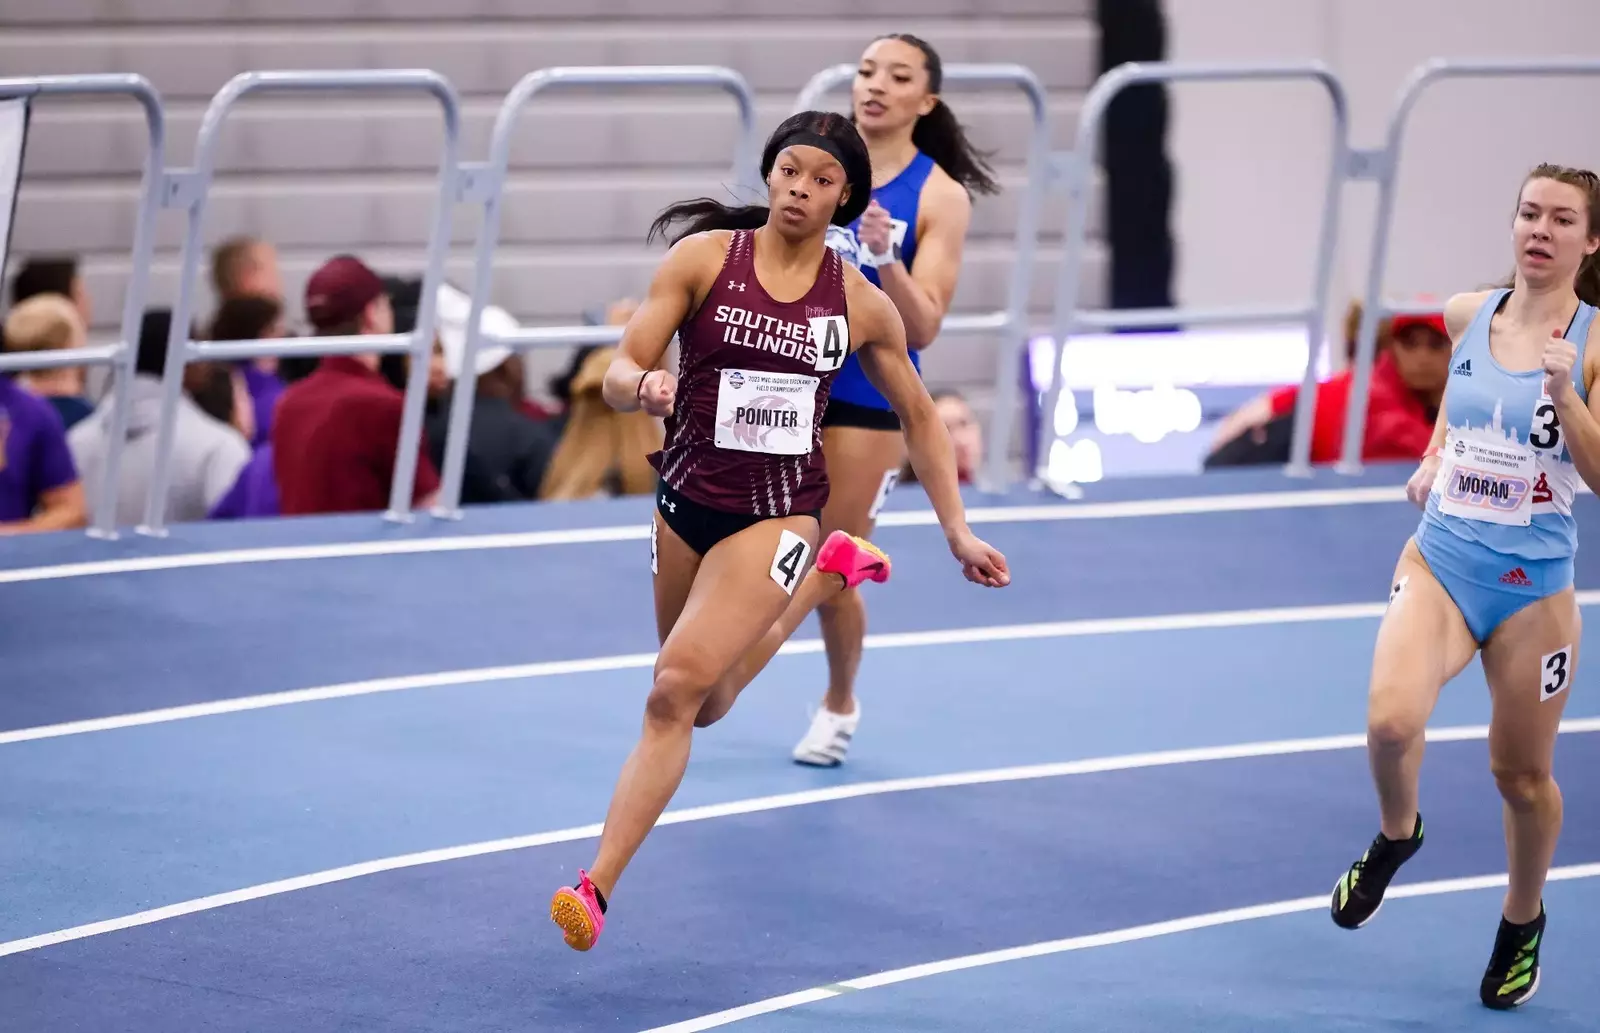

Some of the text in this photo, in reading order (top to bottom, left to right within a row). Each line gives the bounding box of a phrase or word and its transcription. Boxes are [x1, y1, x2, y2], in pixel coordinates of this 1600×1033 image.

[714, 305, 817, 343] SOUTHER
[823, 319, 842, 367] 4
[723, 326, 818, 365] ILLINOIS
[736, 407, 798, 427] POINTER
[1529, 404, 1561, 449] 3
[1459, 474, 1509, 499] MORAN
[777, 541, 806, 588] 4
[1498, 577, 1532, 586] adidas
[1545, 651, 1567, 694] 3
